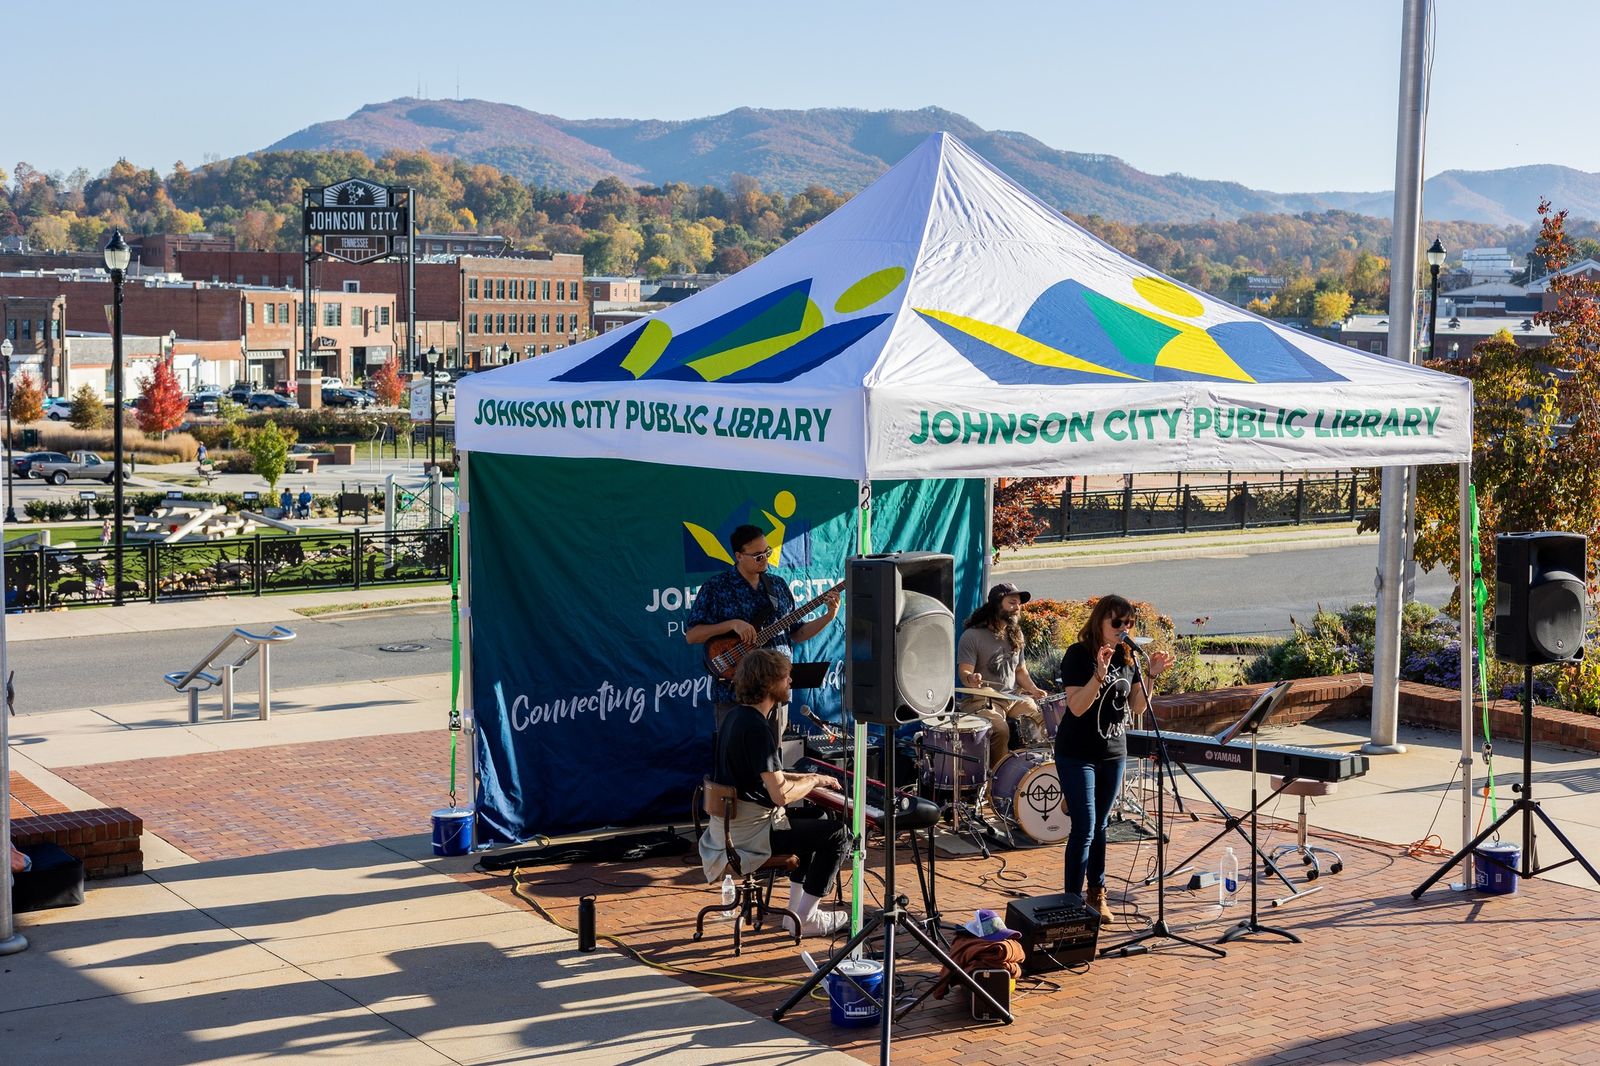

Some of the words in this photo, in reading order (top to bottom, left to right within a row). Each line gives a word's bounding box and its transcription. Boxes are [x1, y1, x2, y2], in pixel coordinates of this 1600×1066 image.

[310, 211, 365, 230] JOHNSON
[371, 211, 399, 230] CITY
[341, 237, 369, 248] TENNESSEE
[474, 399, 567, 428] JOHNSON
[571, 400, 621, 429] CITY
[626, 401, 709, 435] PUBLIC
[713, 407, 832, 442] LIBRARY
[908, 410, 1094, 446] JOHNSON
[1102, 408, 1184, 442] CITY
[1192, 407, 1305, 440] PUBLIC
[1313, 406, 1441, 439] LIBRARY
[511, 680, 646, 732] Connecting
[654, 674, 713, 713] peopl
[1213, 751, 1241, 763] YAMAHA
[1058, 923, 1086, 934] Roland
